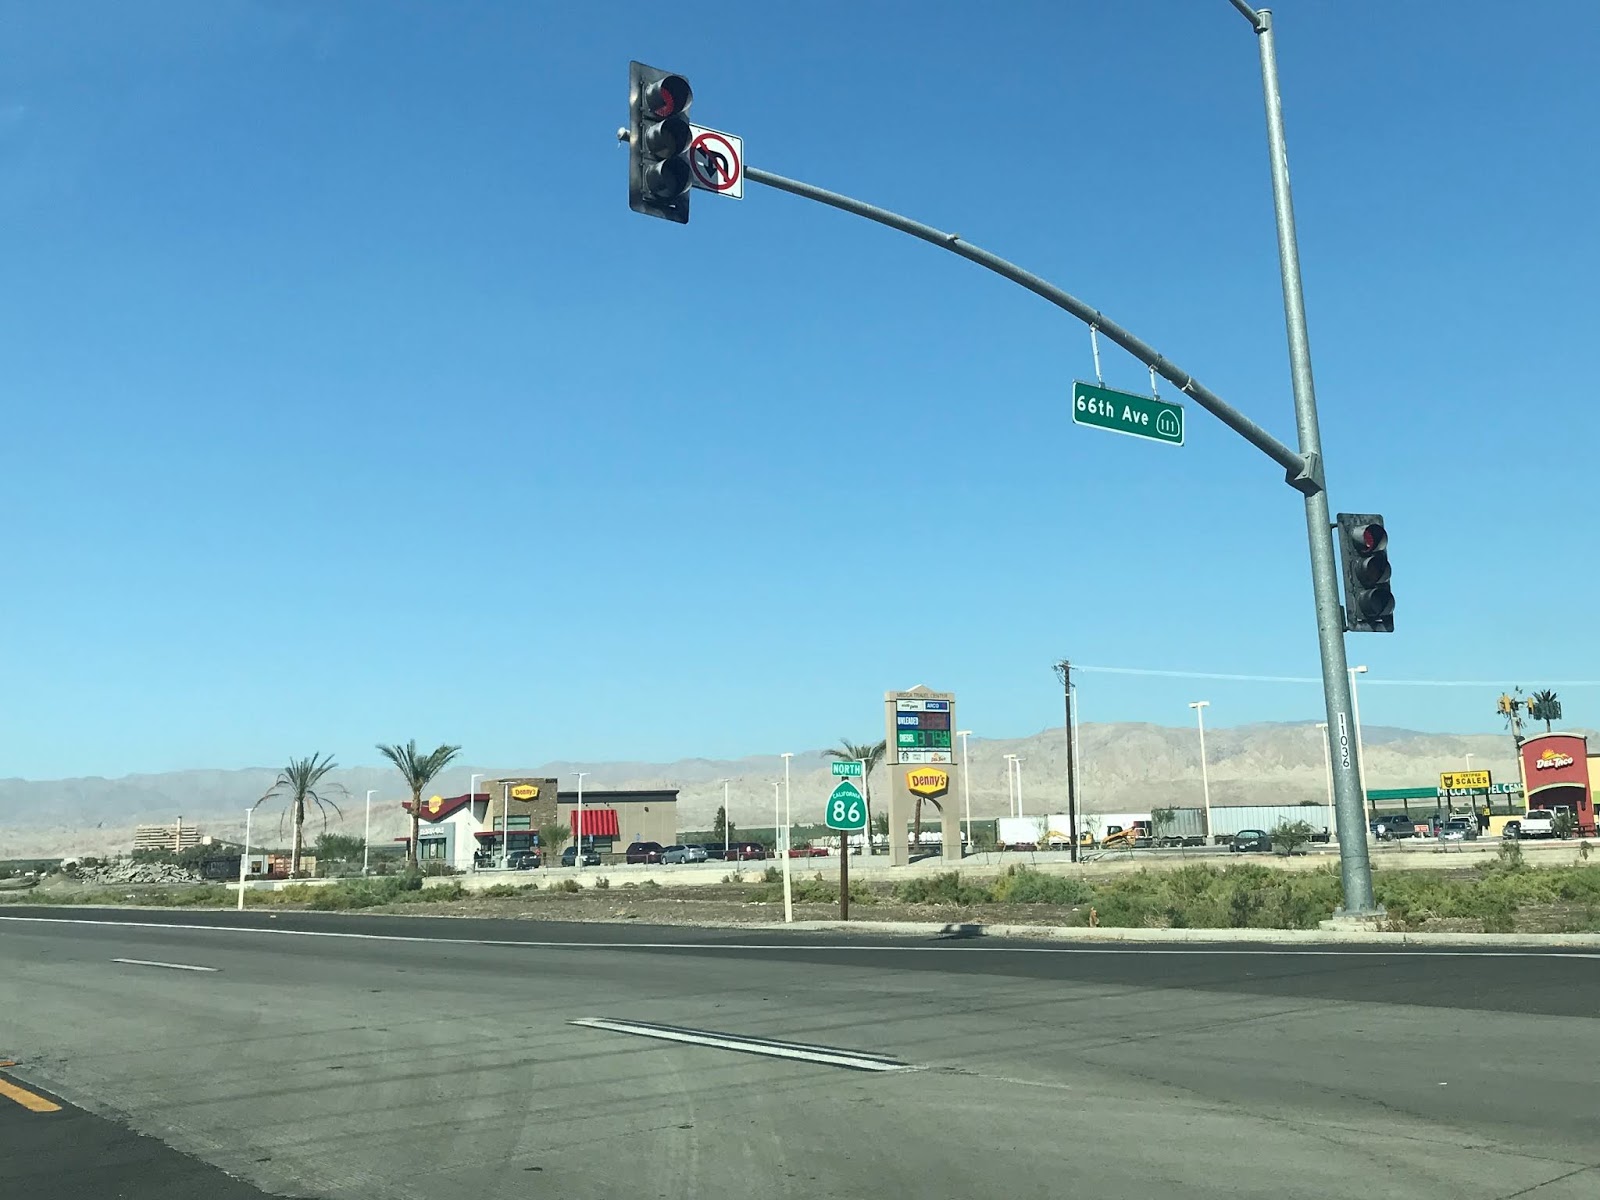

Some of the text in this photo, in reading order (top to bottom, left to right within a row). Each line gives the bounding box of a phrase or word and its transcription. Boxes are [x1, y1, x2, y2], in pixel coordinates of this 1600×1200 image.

[1077, 395, 1175, 432] 66th Ave 111
[1340, 714, 1350, 767] 11036
[833, 764, 861, 775] NORTH
[1536, 759, 1554, 769] DEL
[912, 774, 945, 787] Denny's
[1455, 777, 1487, 785] SCALES
[832, 790, 861, 799] CALIFORNIA
[833, 800, 860, 823] 86
